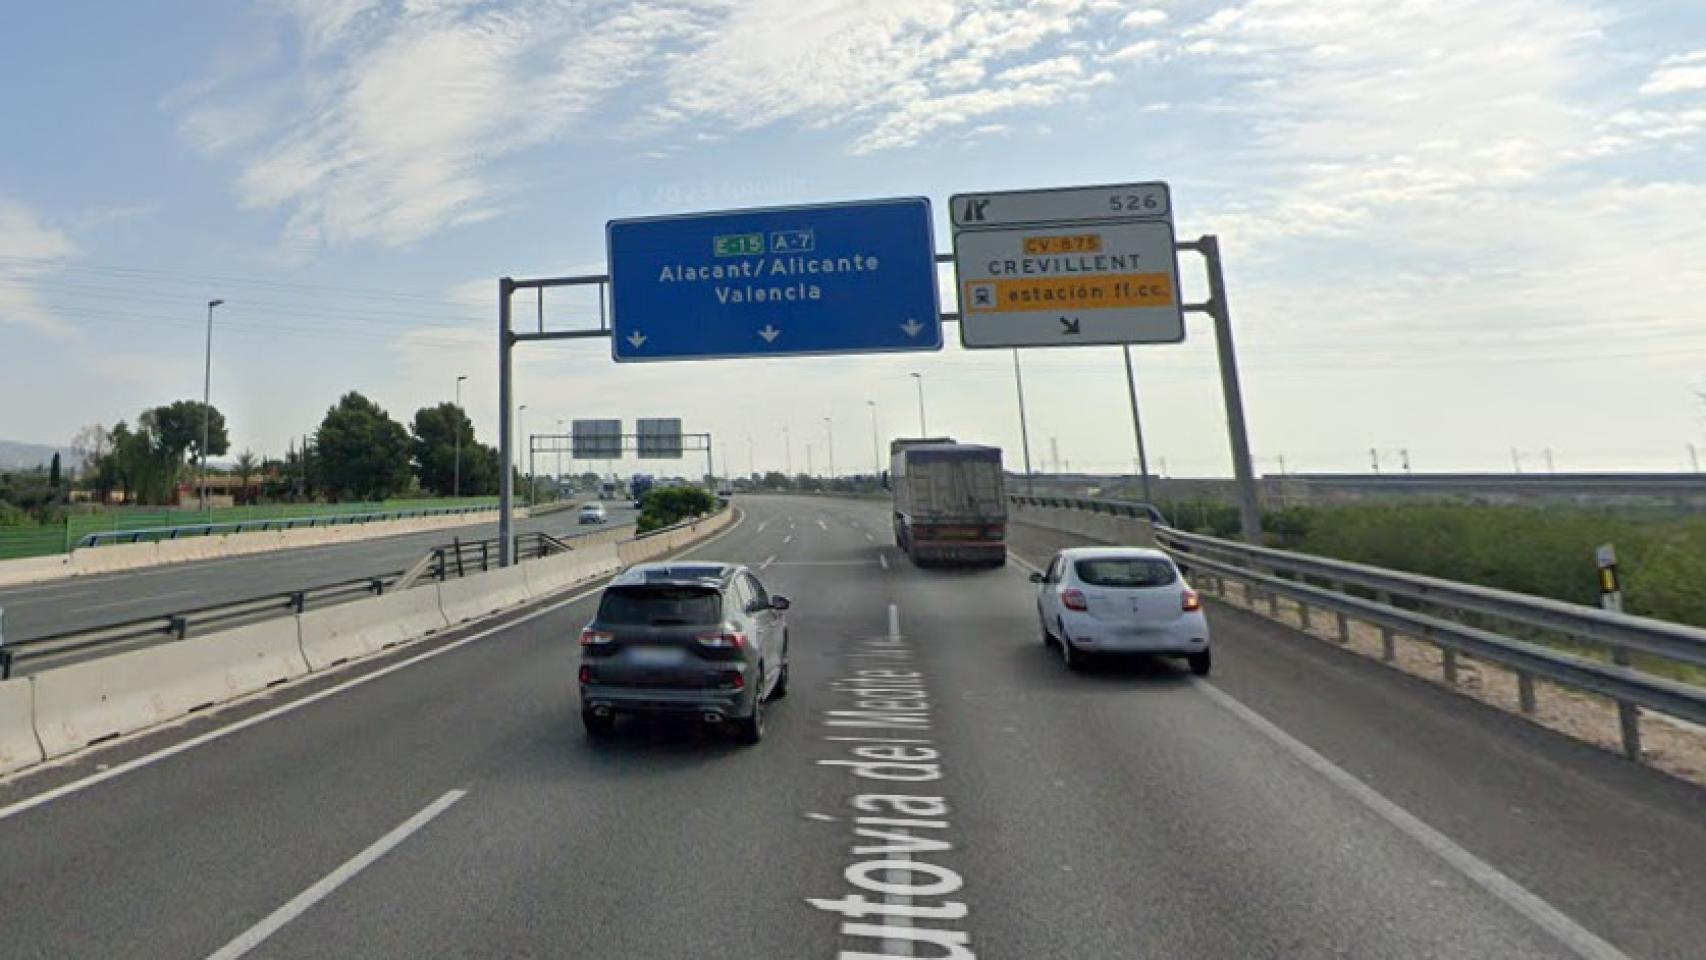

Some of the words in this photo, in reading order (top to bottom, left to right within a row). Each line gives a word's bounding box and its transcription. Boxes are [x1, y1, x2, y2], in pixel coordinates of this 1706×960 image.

[1109, 193, 1158, 211] 526
[716, 237, 761, 254] E-15
[775, 233, 810, 250] A-7
[1026, 236, 1099, 253] CV-875
[659, 256, 879, 282] Alacant/Alicante
[988, 254, 1141, 275] CREVILLENT
[715, 283, 821, 304] Valencia
[1008, 281, 1103, 302] estación
